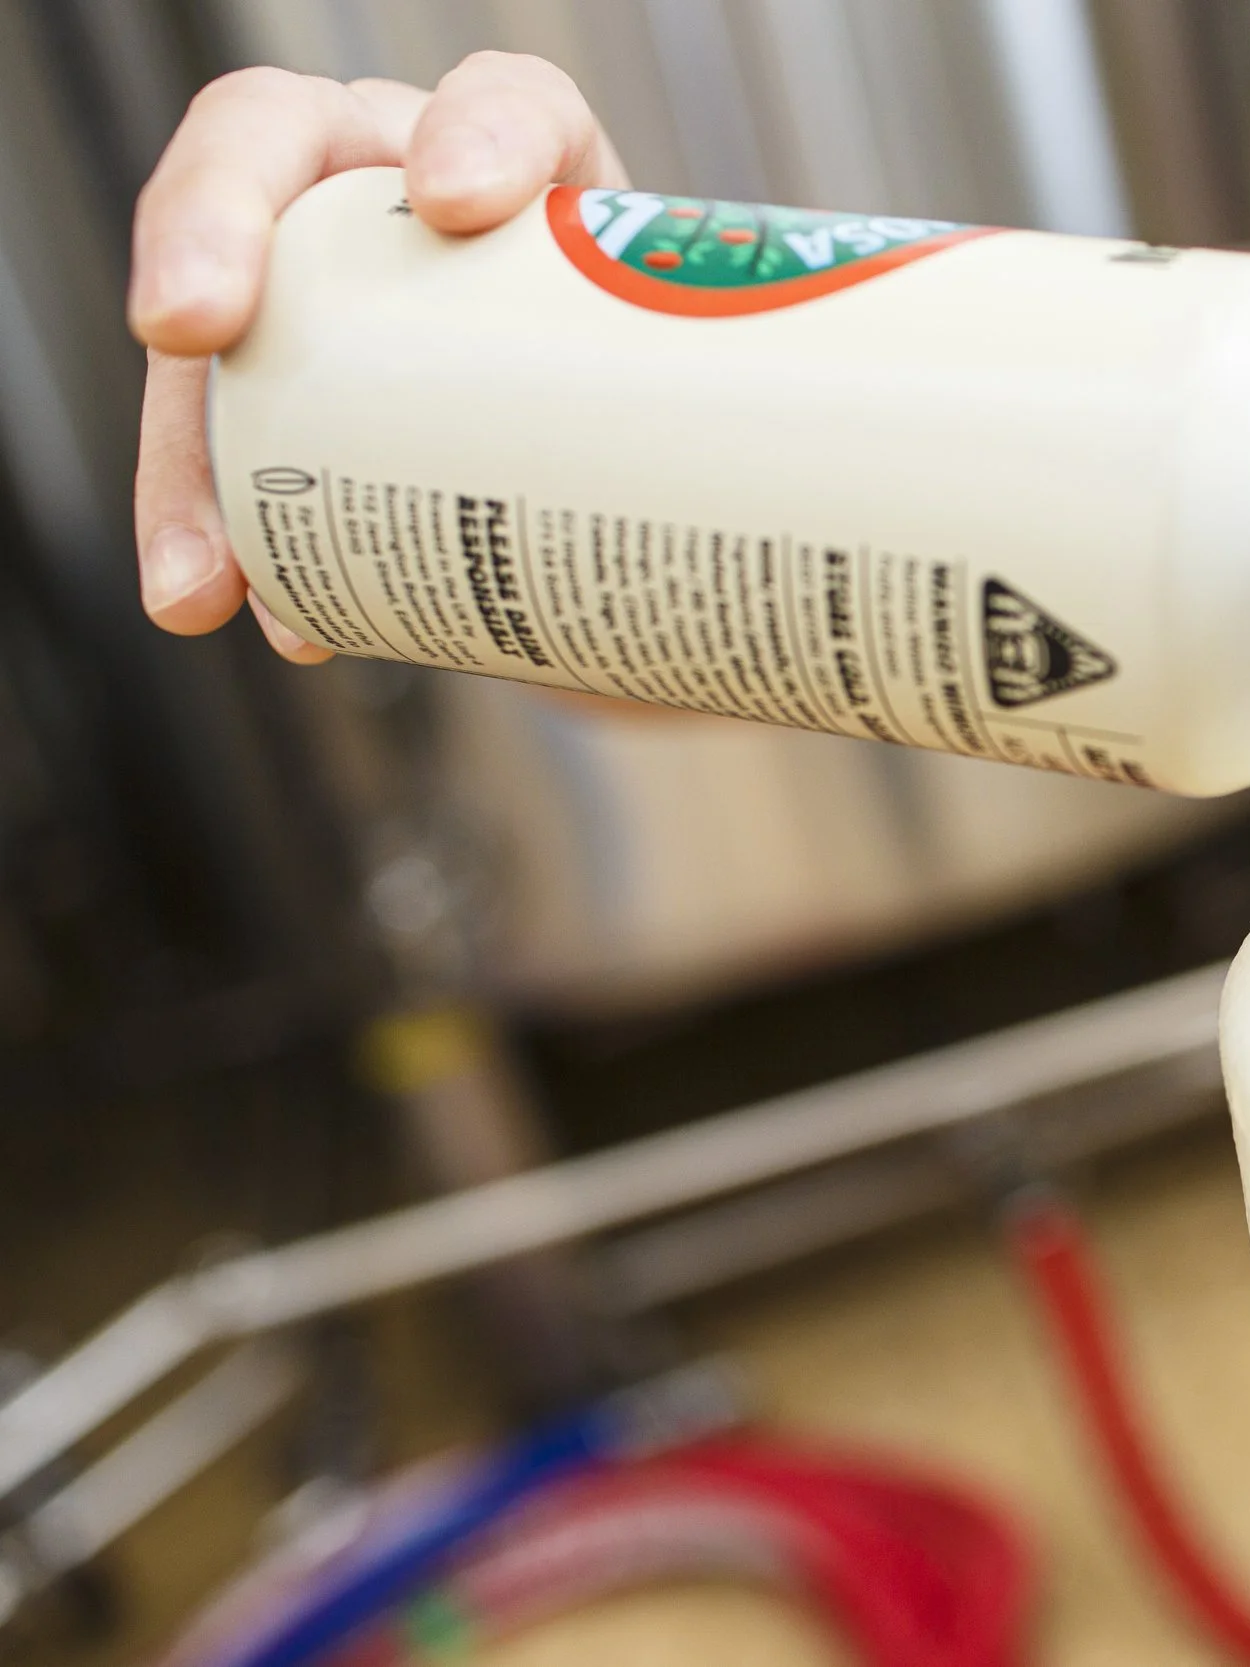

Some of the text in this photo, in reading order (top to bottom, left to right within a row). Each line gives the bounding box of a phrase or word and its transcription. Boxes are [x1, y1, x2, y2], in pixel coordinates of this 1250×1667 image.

[273, 563, 311, 615] Against
[303, 615, 347, 649] Sewage
[312, 600, 353, 641] donated
[316, 569, 333, 592] the
[327, 594, 348, 618] sale
[353, 630, 375, 647] this
[458, 496, 524, 660] RESPONSIBLY
[485, 499, 521, 602] PLEASE
[505, 608, 556, 669] DRINK
